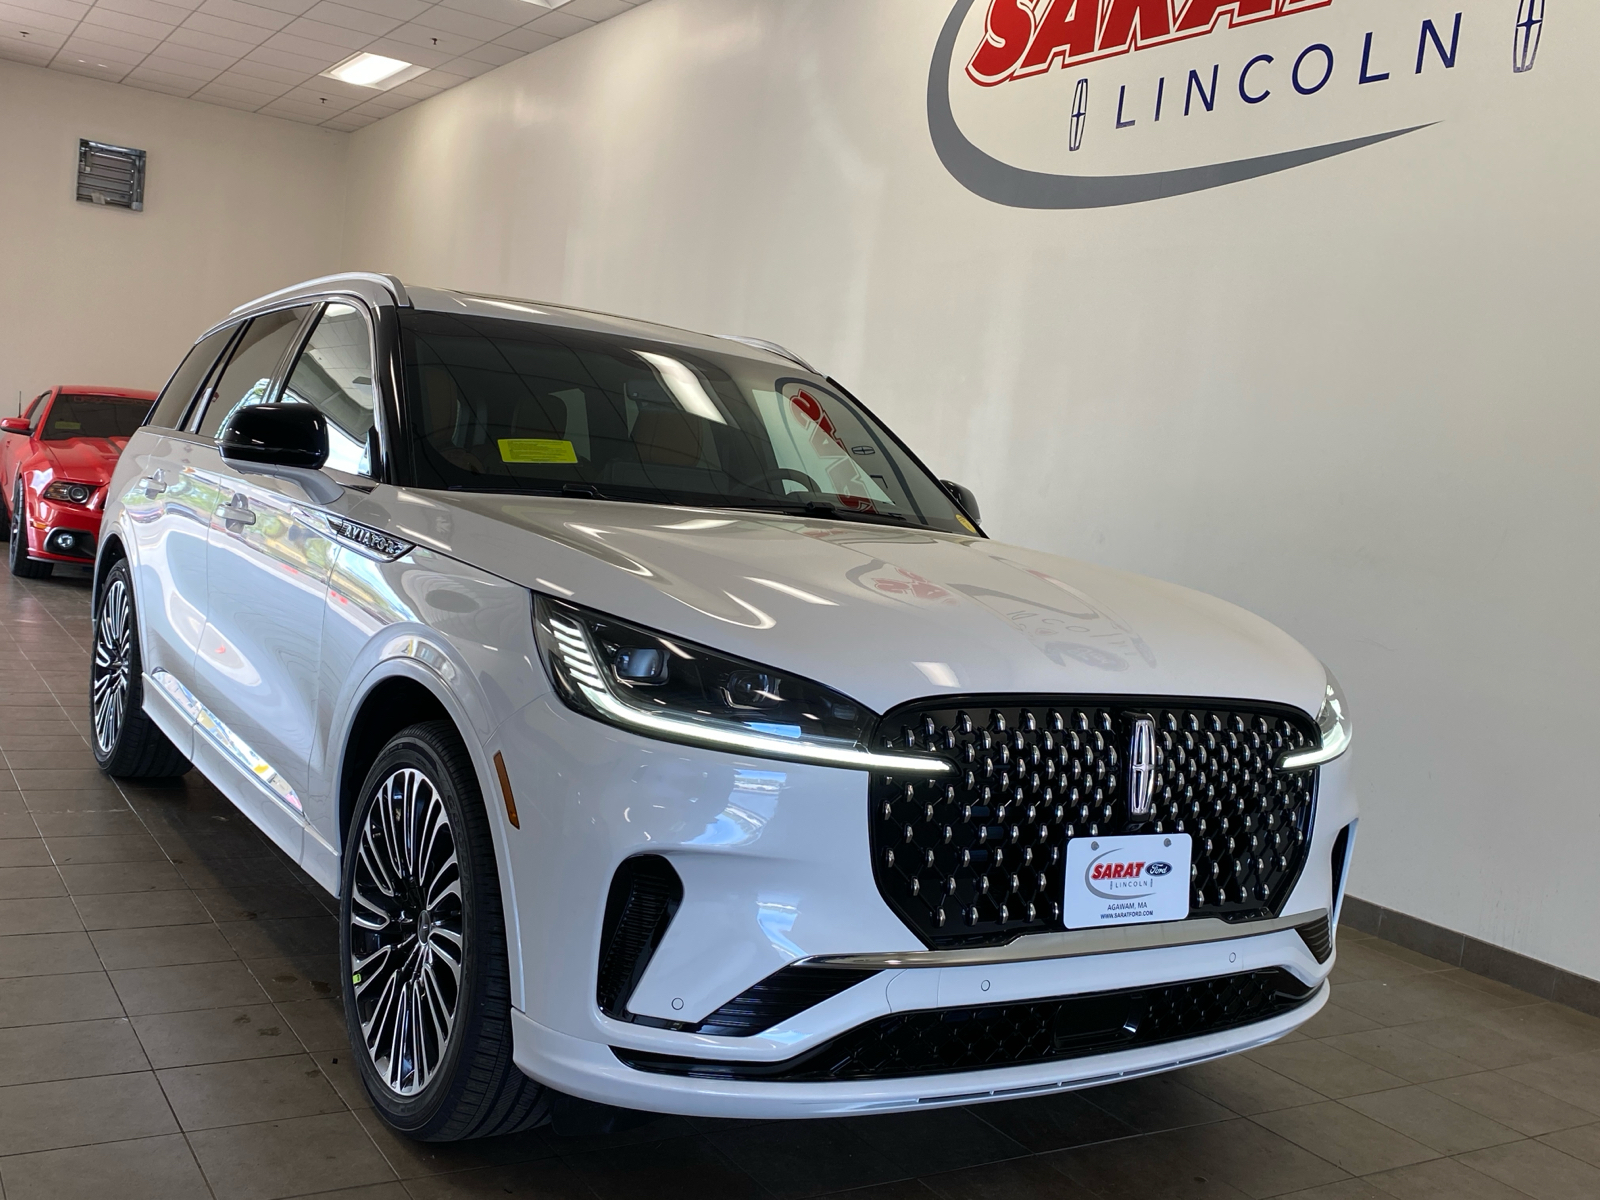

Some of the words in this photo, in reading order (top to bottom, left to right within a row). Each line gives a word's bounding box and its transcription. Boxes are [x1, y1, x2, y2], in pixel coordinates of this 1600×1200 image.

[1115, 12, 1463, 129] LINCOLN
[1091, 861, 1146, 880] SARAT
[1149, 863, 1168, 875] Ford
[1115, 880, 1148, 888] LINCOLN
[1107, 902, 1136, 910] AGAWAM,
[1100, 910, 1153, 919] WWW.SARATFORD.COM
